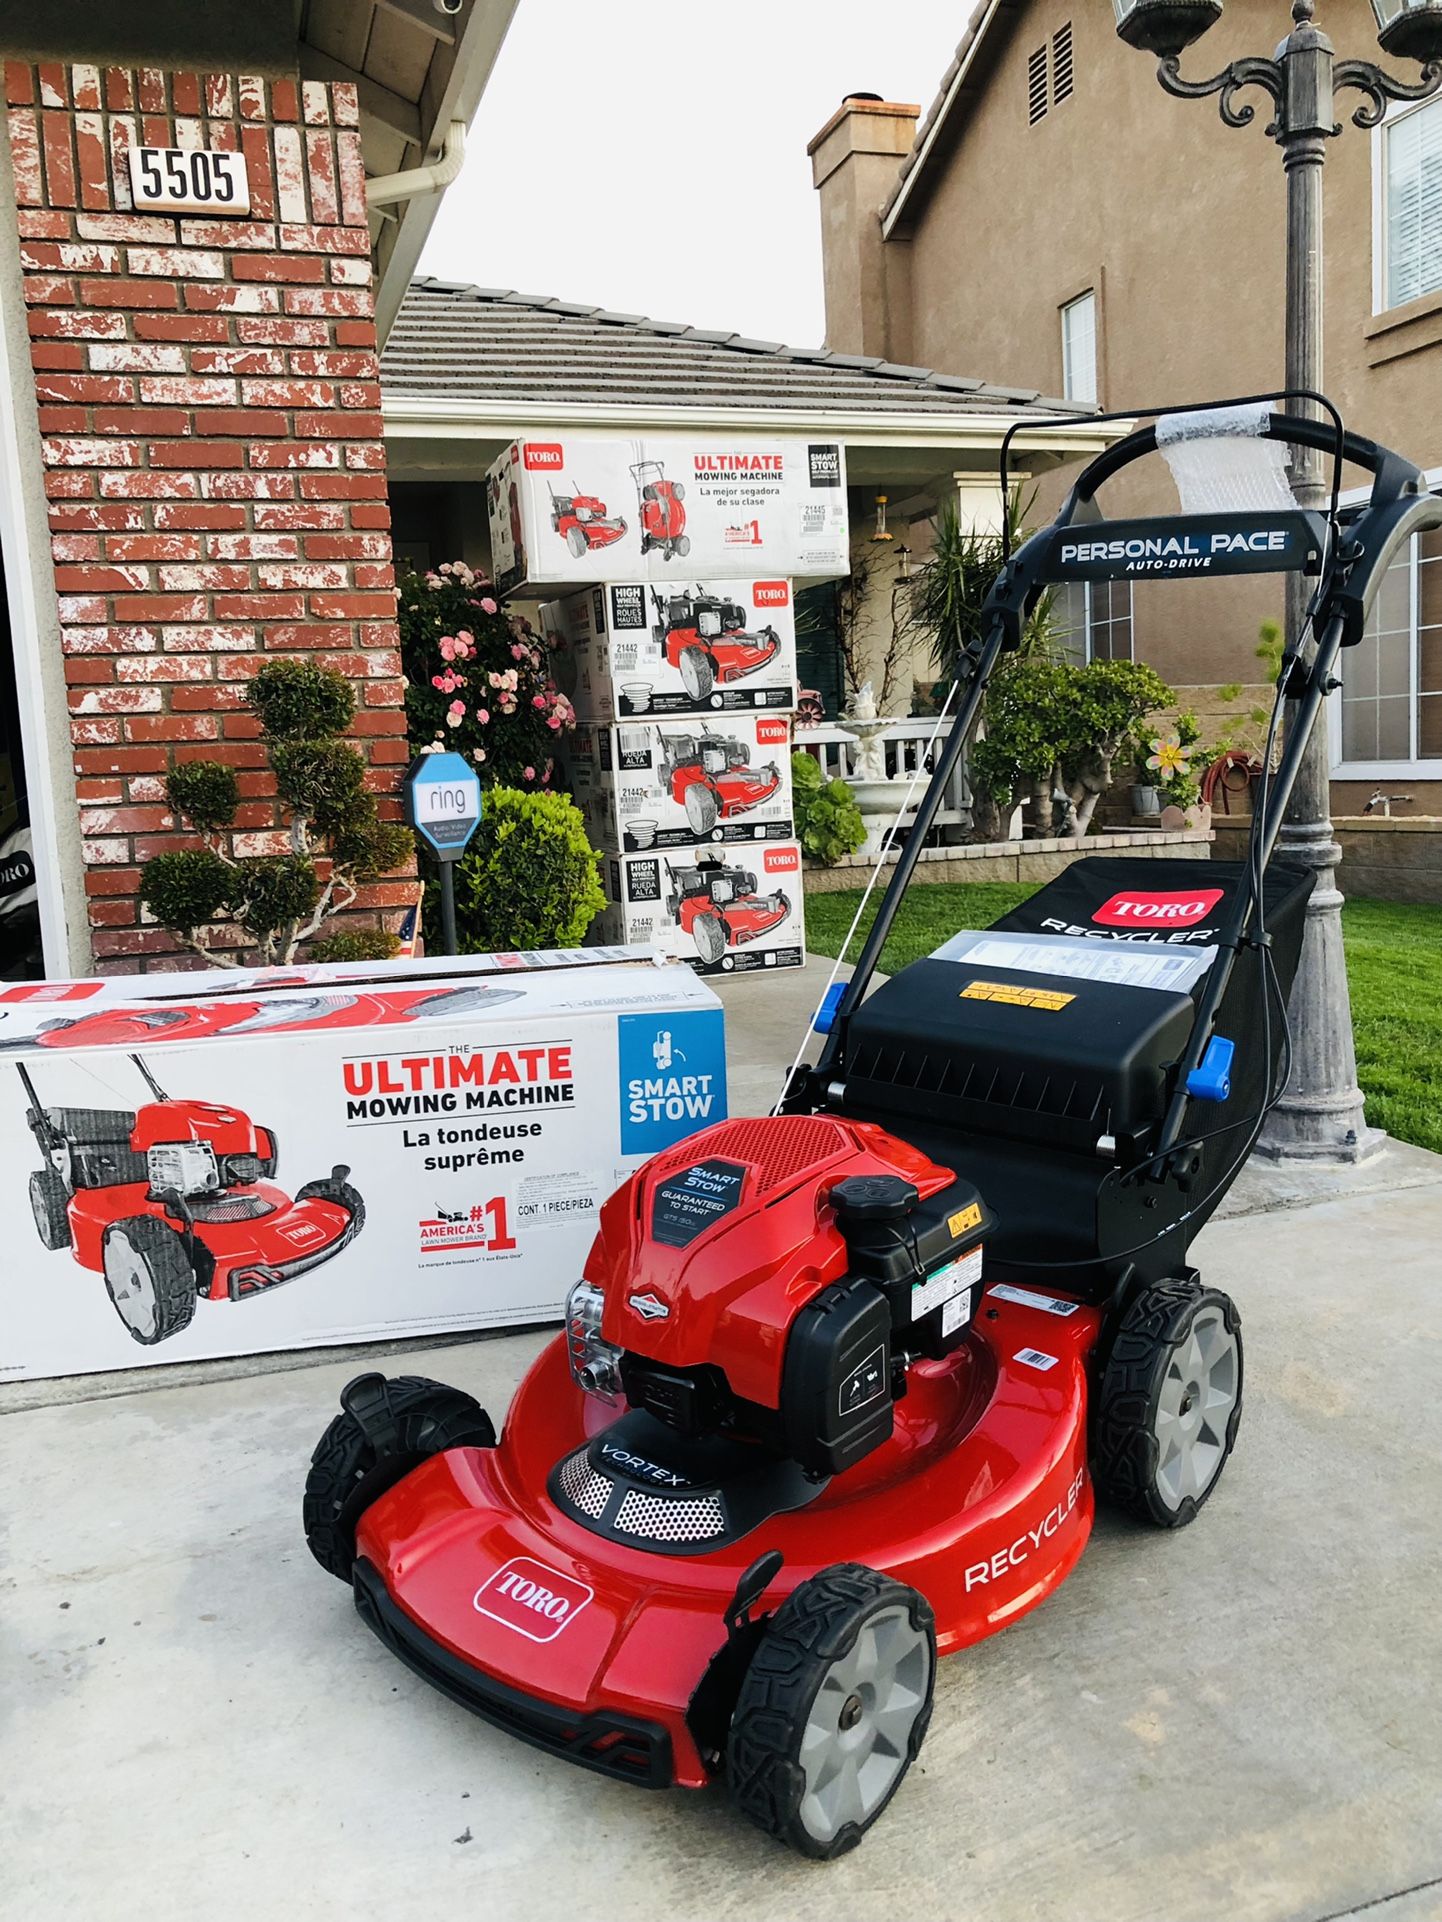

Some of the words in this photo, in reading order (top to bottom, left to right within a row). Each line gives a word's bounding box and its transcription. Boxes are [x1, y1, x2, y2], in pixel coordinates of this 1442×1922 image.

[140, 149, 234, 202] 5505
[527, 451, 560, 463] TORO
[694, 455, 783, 471] ULTIMATE
[810, 453, 837, 461] SMART
[811, 461, 838, 470] STOW
[694, 472, 737, 481] MOWING
[740, 472, 784, 480] MACHINE
[700, 487, 711, 496] La
[713, 488, 738, 497] mejor
[740, 487, 780, 497] segadora
[716, 498, 727, 506] de
[742, 498, 765, 506] clase
[1061, 536, 1200, 563] PERSONAL
[1211, 531, 1286, 553] PACE
[1126, 557, 1212, 571] AUTO-DRIVE
[615, 588, 641, 598] HIGH
[756, 589, 786, 601] TORO
[616, 608, 642, 617] ROUES
[617, 643, 638, 653] 21442
[759, 725, 786, 738] TORO
[431, 785, 466, 814] ring
[630, 862, 655, 872] HIGH
[767, 855, 797, 867] TORO
[631, 881, 656, 890] RUEDA
[635, 888, 654, 896] ALTA
[1112, 900, 1206, 919] TORO
[632, 918, 653, 927] 21442
[1040, 917, 1214, 944] RECYCLER
[449, 1044, 470, 1054] THE
[343, 1046, 573, 1096] ULTIMATE
[628, 1075, 713, 1100] SMART
[346, 1092, 457, 1120] MOWING
[465, 1083, 574, 1110] MACHINE
[629, 1094, 713, 1123] STOW
[403, 1129, 430, 1148] La
[437, 1122, 542, 1144] tondeuse
[424, 1147, 525, 1172] suprême
[688, 1167, 740, 1185] SMART
[684, 1176, 727, 1193] STOW
[661, 1190, 726, 1211] GUARANTEED
[517, 1204, 541, 1216] CONT.
[542, 1203, 547, 1213] 1
[669, 1201, 681, 1209] TO
[681, 1204, 710, 1216] START
[286, 1225, 317, 1240] TORO
[420, 1223, 485, 1238] AMERICA'S
[421, 1237, 440, 1246] LAWN
[440, 1235, 464, 1244] MOWER
[464, 1233, 487, 1242] BRAND
[601, 1443, 686, 1487] VORTEX
[964, 1467, 1084, 1593] RECYCLER
[495, 1570, 570, 1619] TORO
